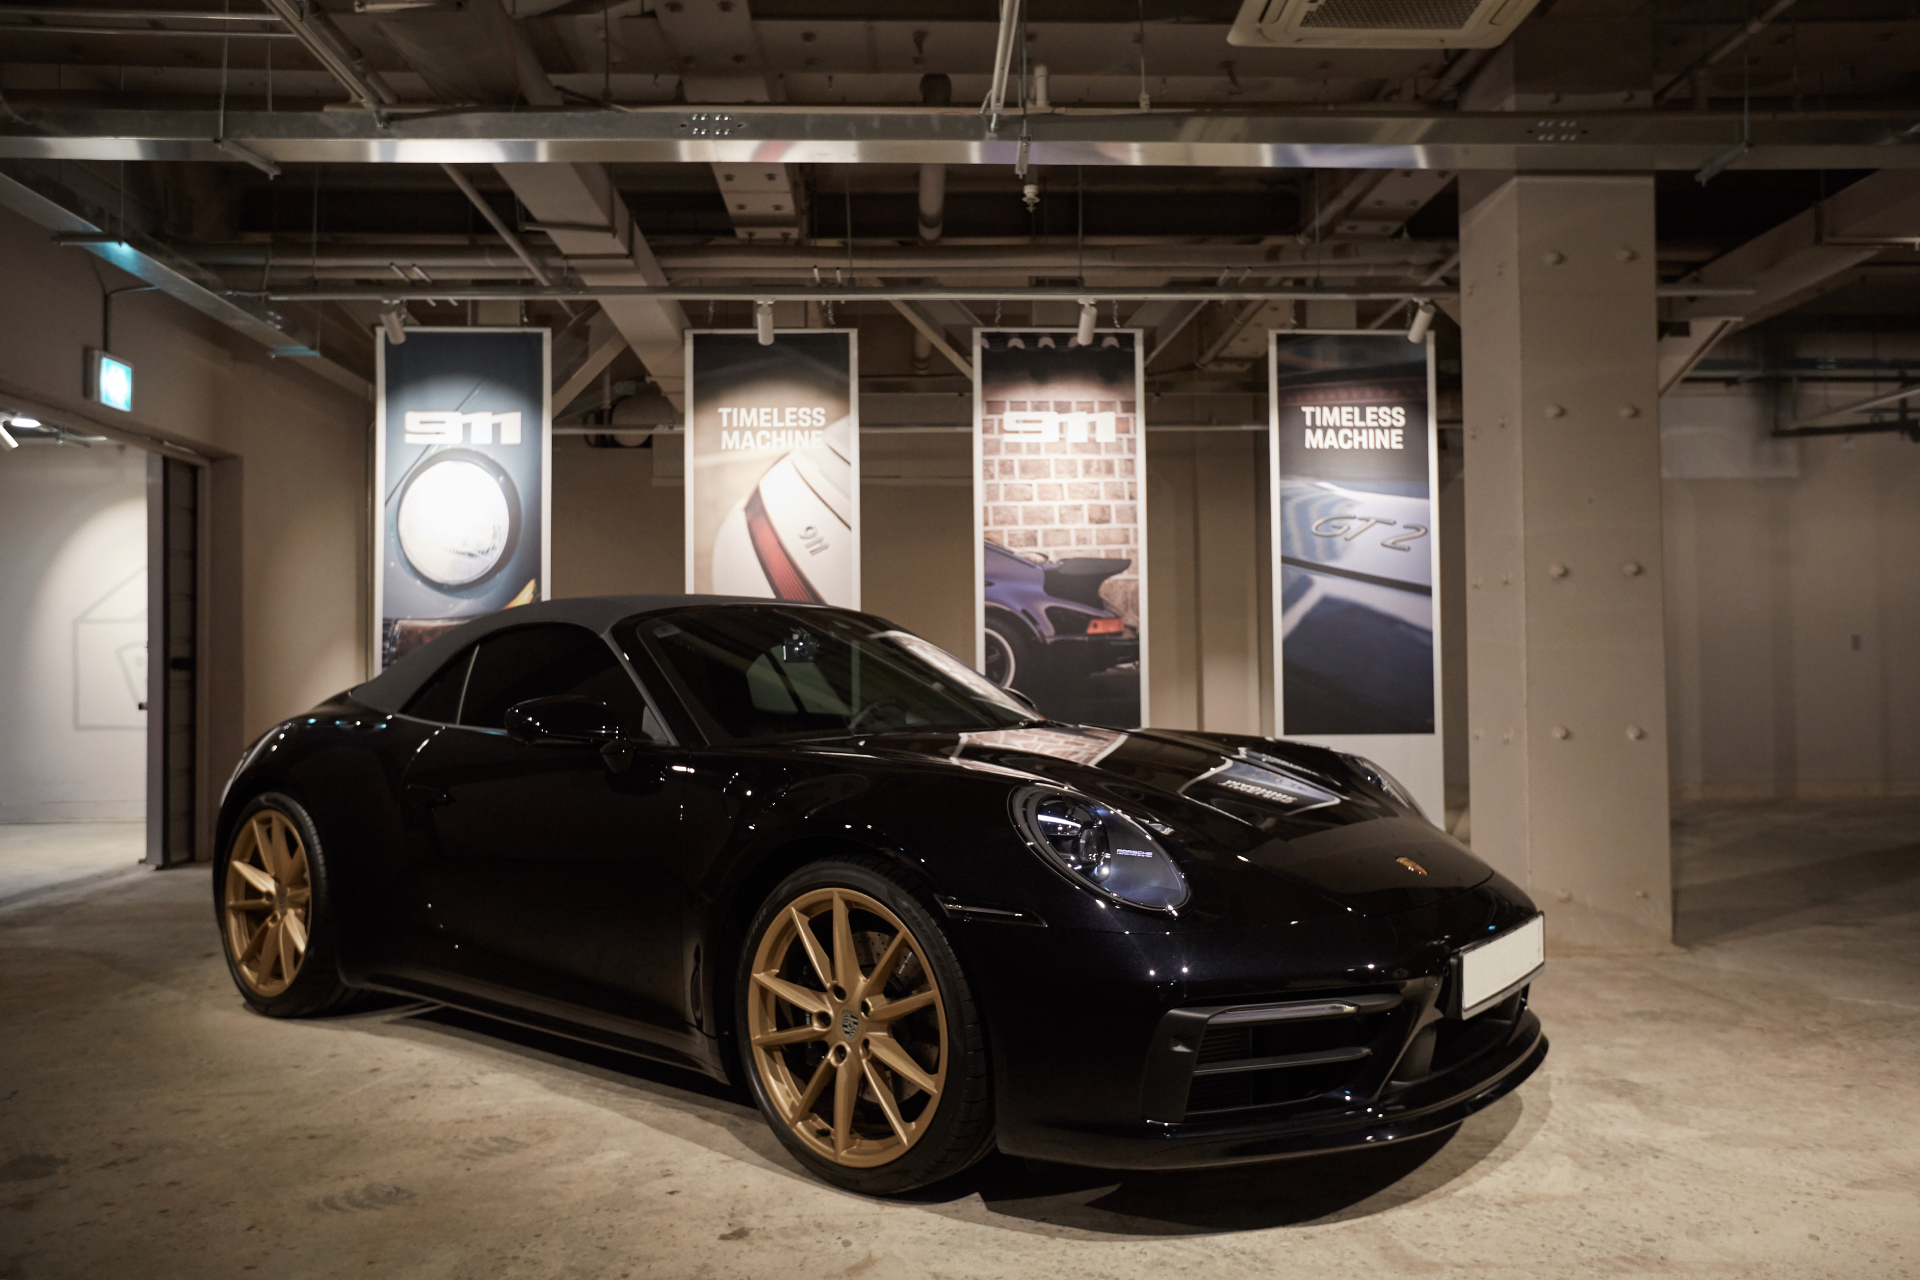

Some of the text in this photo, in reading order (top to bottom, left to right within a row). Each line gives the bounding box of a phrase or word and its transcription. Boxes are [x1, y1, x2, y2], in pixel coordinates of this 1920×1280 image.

[718, 407, 826, 428] TIMELESS
[1003, 411, 1117, 443] 911
[1301, 406, 1406, 427] TIMELESS
[404, 411, 522, 445] 911
[1304, 428, 1404, 449] MACHINE
[721, 430, 824, 450] MACHINE
[799, 525, 830, 557] 911
